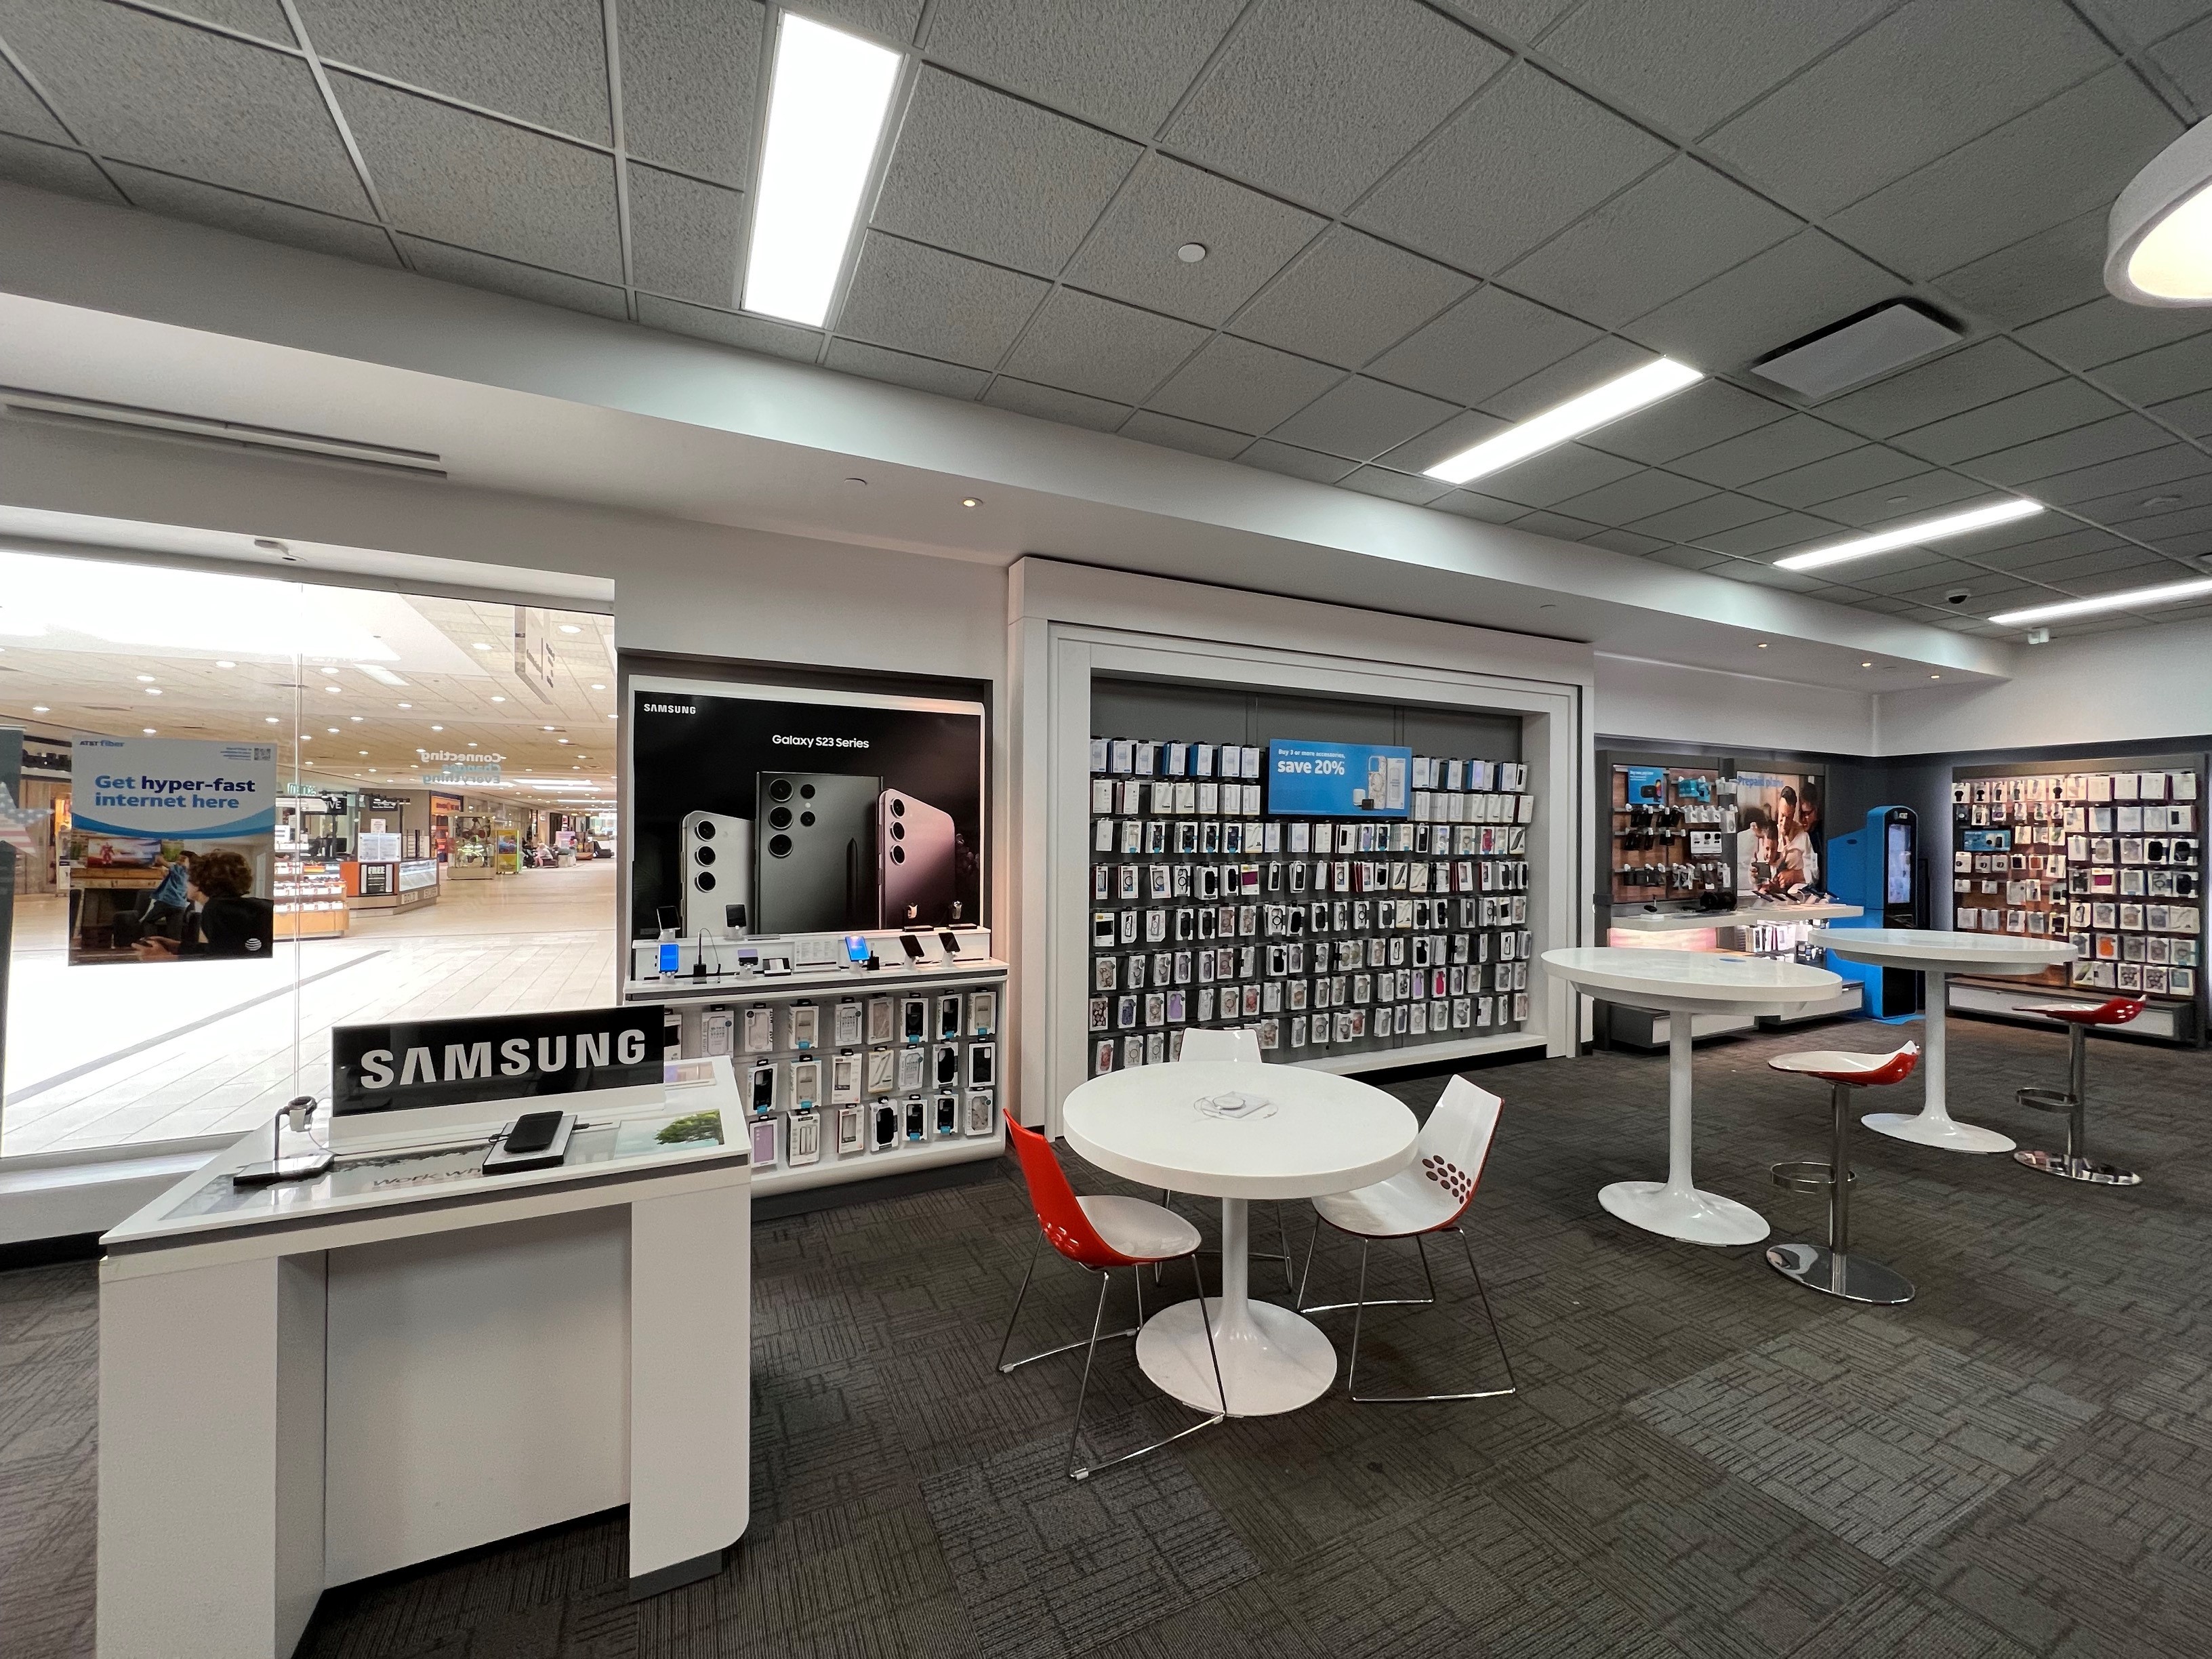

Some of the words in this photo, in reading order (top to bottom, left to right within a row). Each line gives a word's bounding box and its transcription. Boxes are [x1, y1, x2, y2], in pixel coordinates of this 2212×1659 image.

[643, 703, 697, 715] SAMSUNG
[772, 734, 815, 748] Galaxy
[815, 737, 834, 747] S23
[836, 738, 869, 749] Series
[1278, 748, 1289, 756] Buy
[1277, 760, 1312, 774] save
[95, 775, 136, 790] Get
[141, 776, 255, 794] hyper-fast
[95, 792, 186, 808] internet
[192, 794, 240, 808] here
[360, 1029, 647, 1089] SAMSUNG
[373, 1173, 438, 1187] Work
